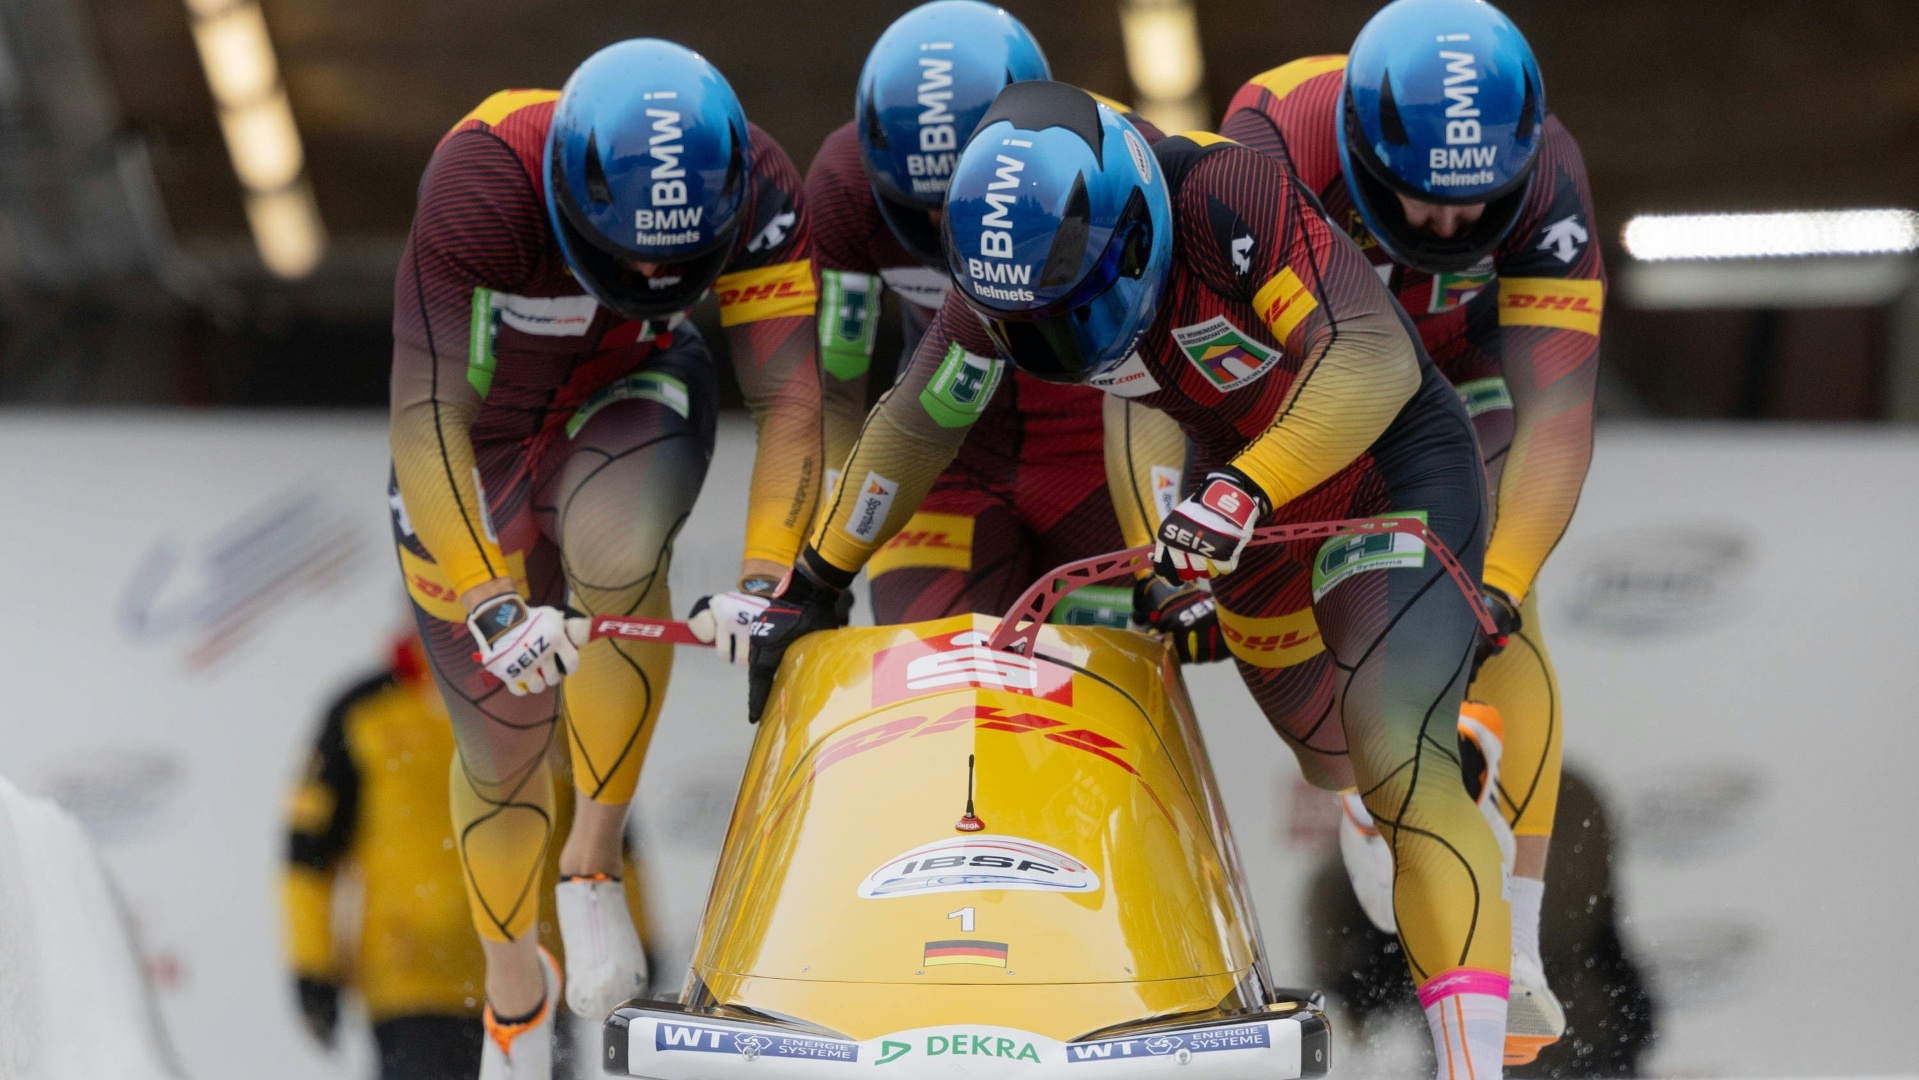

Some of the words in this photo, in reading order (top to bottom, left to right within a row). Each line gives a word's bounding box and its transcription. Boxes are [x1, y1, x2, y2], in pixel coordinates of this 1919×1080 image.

[919, 42, 954, 51] i
[1436, 34, 1471, 43] i
[643, 91, 677, 100] i
[917, 57, 957, 152] BMW
[1439, 51, 1481, 145] BMW
[1002, 139, 1033, 148] i
[646, 108, 688, 206] BMW
[1429, 146, 1497, 169] BMW
[1430, 169, 1495, 187] helmets
[635, 206, 703, 230] BMW
[980, 154, 1025, 259] BMW
[636, 230, 701, 246] helmets
[968, 258, 1032, 285] BMW
[719, 281, 801, 308] DHL
[973, 281, 1035, 302] helmets
[1507, 293, 1593, 313] DHL
[1221, 622, 1311, 652] DHL
[902, 855, 1059, 875] IBSF
[948, 907, 975, 932] 1
[663, 1025, 729, 1049] WT
[782, 1038, 850, 1051] ENERGIE
[927, 1034, 1042, 1064] DEKRA
[1073, 1040, 1139, 1060] WT
[1192, 1026, 1260, 1040] ENERGIE
[1190, 1034, 1264, 1050] SYSTEME
[779, 1045, 851, 1059] SYSTEME
